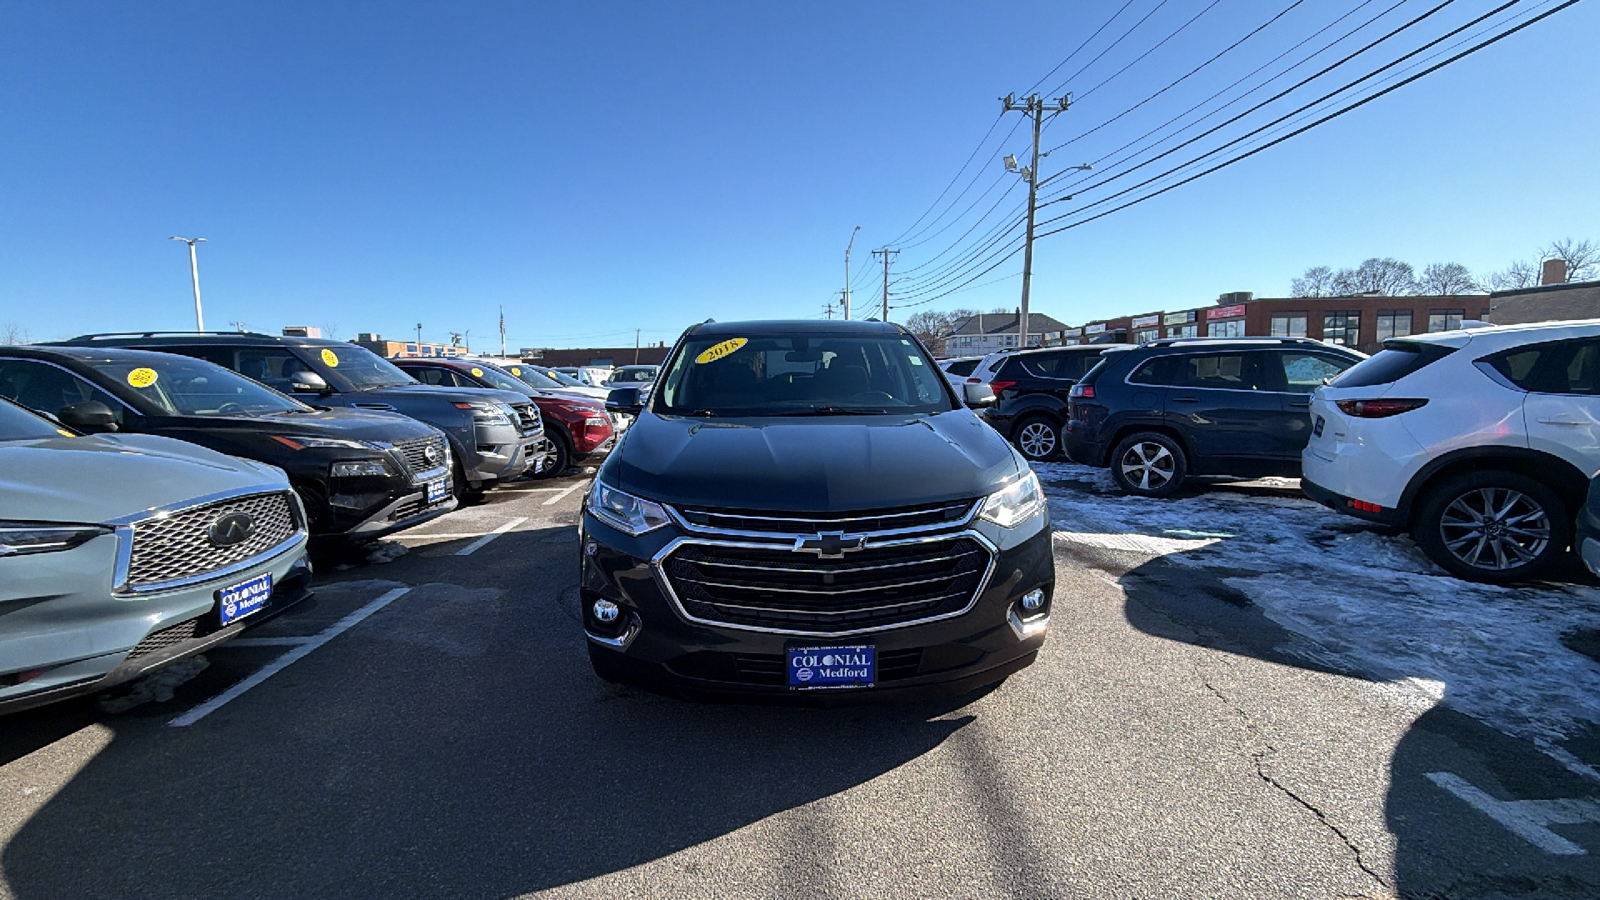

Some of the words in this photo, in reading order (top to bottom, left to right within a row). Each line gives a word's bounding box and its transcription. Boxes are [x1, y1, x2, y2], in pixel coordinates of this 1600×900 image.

[706, 340, 739, 360] 2018
[222, 580, 269, 606] COLONIAL
[239, 591, 268, 610] Medford
[792, 654, 871, 667] COLONIAL
[819, 667, 867, 678] Medford
